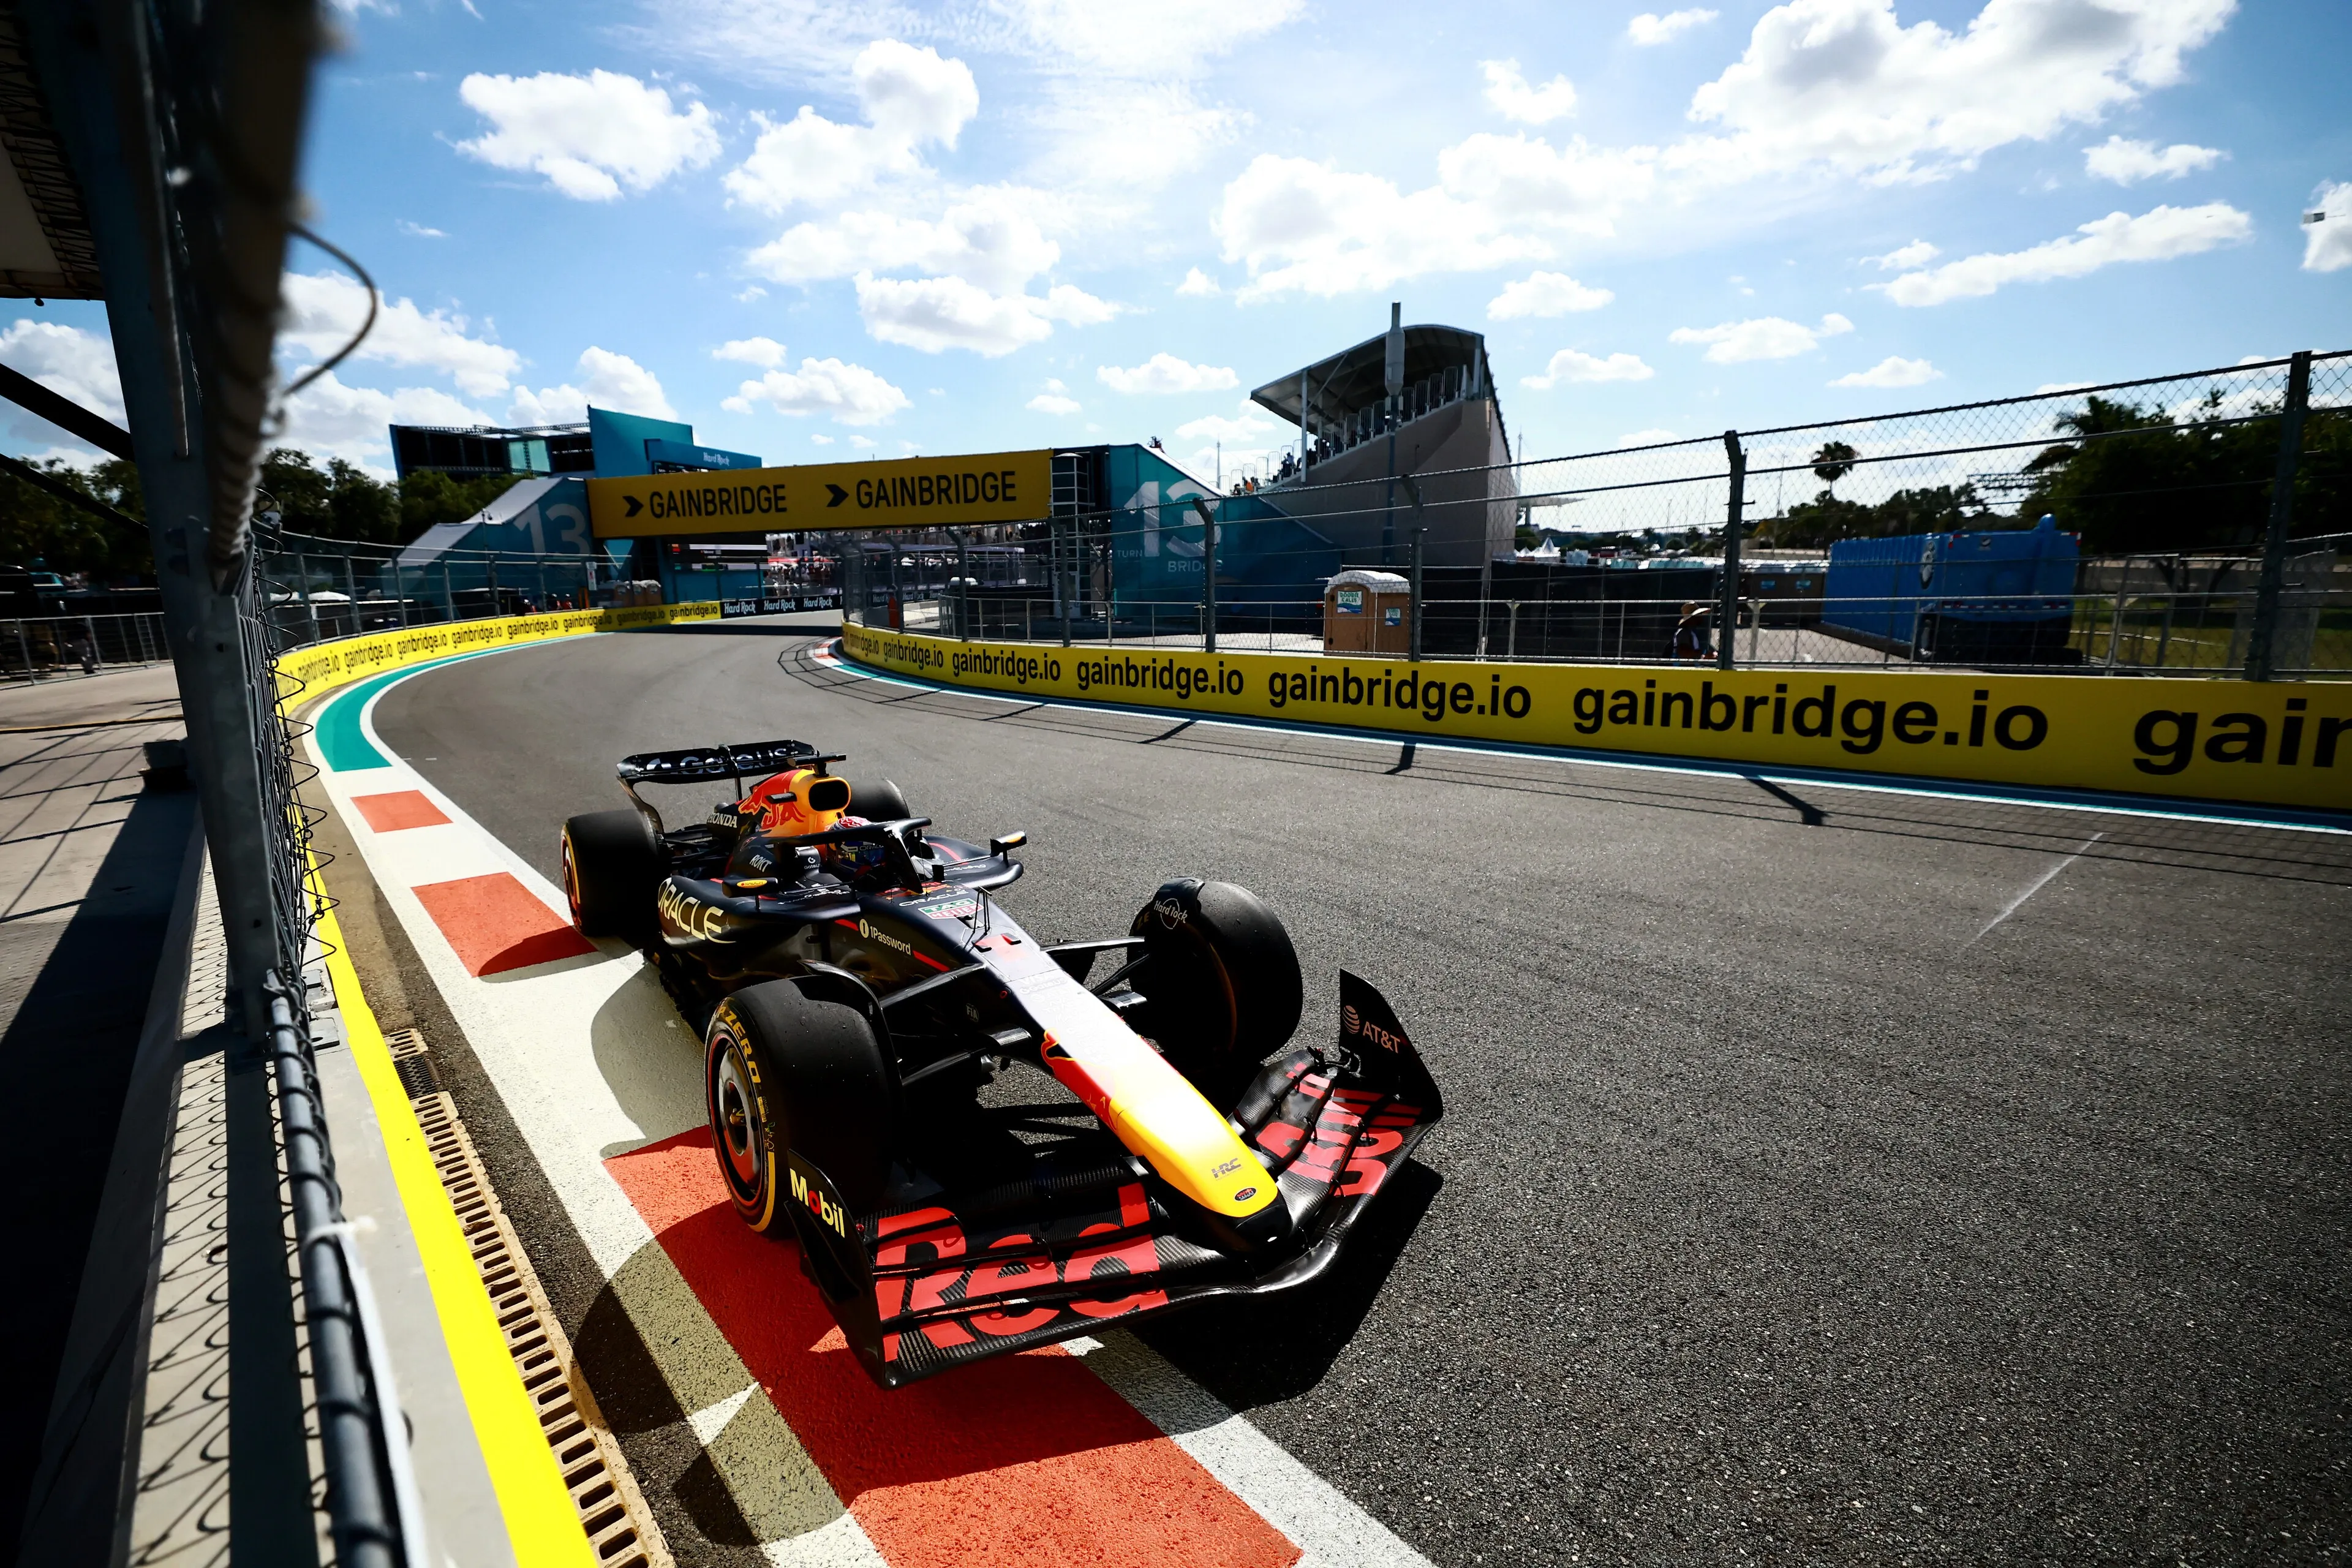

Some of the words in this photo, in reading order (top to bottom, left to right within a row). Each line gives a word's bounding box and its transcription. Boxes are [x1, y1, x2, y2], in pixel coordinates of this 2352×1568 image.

[650, 484, 787, 519] GAINBRIDGE
[856, 470, 1017, 508] GAINBRIDGE
[513, 502, 590, 560] 13
[1124, 478, 1222, 557] 13
[1117, 549, 1143, 558] TURN
[1167, 560, 1223, 573] BRIDE
[617, 608, 665, 625] gainbridge.io
[669, 606, 718, 621] gainbridge.io
[724, 601, 740, 614] Hard
[741, 601, 756, 614] Rock
[764, 600, 780, 611] Hard
[780, 598, 796, 611] Rock
[804, 597, 819, 608] Hard
[819, 596, 832, 608] Rock
[451, 622, 503, 649] gainbridge.io
[507, 616, 559, 639] gainbridge.io
[563, 612, 612, 632] gainbridge.io
[344, 639, 393, 674] gainbridge.io
[396, 629, 448, 660] gainbridge.io
[883, 638, 944, 670] gainbridge.io
[952, 647, 1061, 685] gainbridge.io
[1077, 655, 1244, 700] gainbridge.io
[1268, 664, 1531, 723] gainbridge.io
[1572, 678, 2048, 755] gainbridge.io
[708, 812, 737, 828] HONDA
[658, 877, 736, 944] ORACLE
[899, 890, 969, 907] ORACLE
[924, 899, 975, 913] TAG
[930, 904, 982, 918] HEUER
[1154, 900, 1172, 915] Hard
[869, 925, 911, 956] 1Password
[724, 1009, 761, 1084] ZERO
[1362, 1021, 1401, 1054] AT&T
[1211, 1157, 1242, 1178] HRC
[790, 1167, 845, 1238] Mobil
[875, 1182, 1169, 1363] Red
